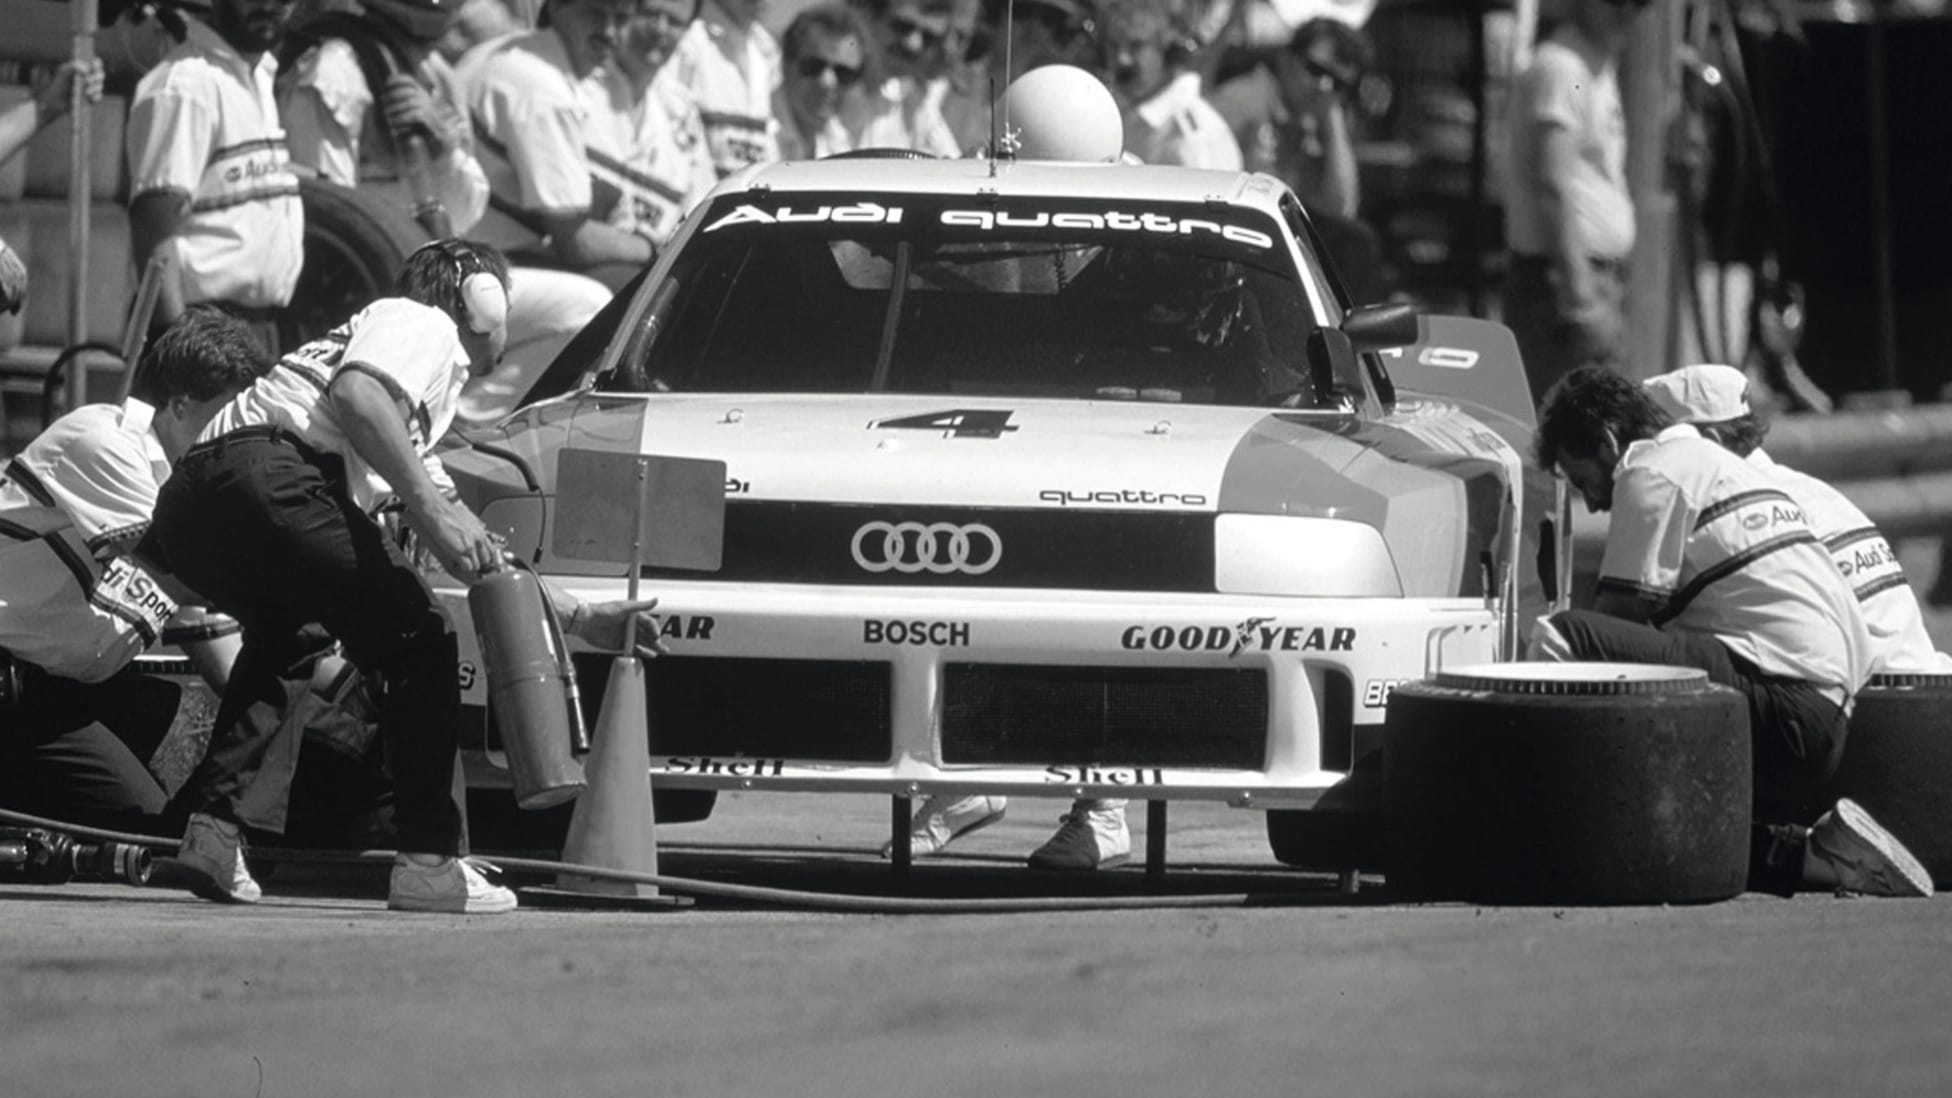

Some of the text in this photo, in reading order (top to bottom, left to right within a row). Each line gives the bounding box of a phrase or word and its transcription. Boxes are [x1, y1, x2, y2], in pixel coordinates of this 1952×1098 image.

[703, 203, 903, 232] Audi
[940, 210, 1273, 248] quattro
[866, 409, 1020, 439] 4
[1039, 490, 1206, 506] quattro
[864, 620, 969, 647] BOSCH
[665, 757, 784, 776] Shell
[1045, 766, 1162, 785] Shell
